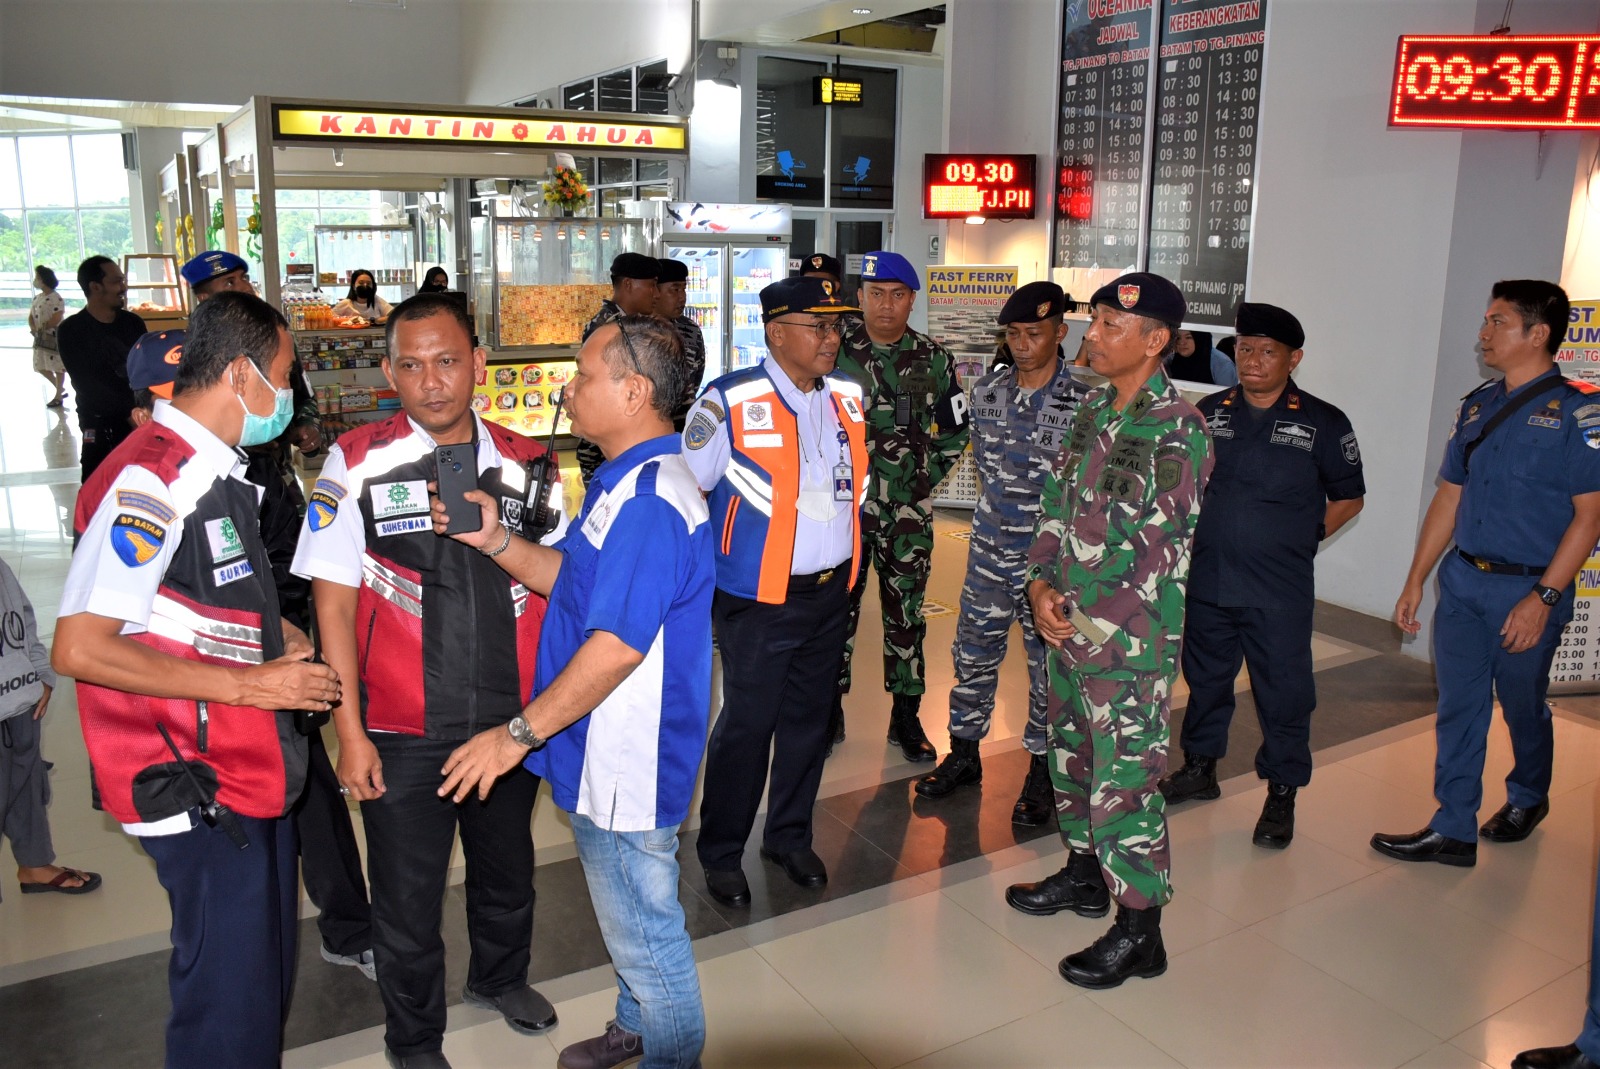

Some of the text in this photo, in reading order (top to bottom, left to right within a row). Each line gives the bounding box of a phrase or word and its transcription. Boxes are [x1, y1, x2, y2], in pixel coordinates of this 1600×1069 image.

[1169, 0, 1260, 34] KEBERANGKATAN
[1097, 22, 1139, 45] JADWAL
[1160, 30, 1265, 57] BATAM TO TG.PINANG
[1063, 47, 1151, 72] TG.PINANG TO BATAM
[1405, 55, 1562, 101] 09:30
[319, 114, 654, 146] KANTIN AHUA
[946, 163, 1014, 182] 09.30
[930, 271, 1014, 282] FAST FERRY
[929, 284, 1016, 294] ALUMINIUM
[1182, 280, 1193, 292] TG
[1195, 281, 1226, 295] PINANG
[1233, 283, 1244, 295] PP
[930, 297, 954, 305] BATAM
[971, 298, 998, 306] PINANG
[1186, 301, 1222, 316] CEANNA
[1569, 307, 1595, 323] ST
[1041, 414, 1069, 427] TNI A
[1272, 435, 1311, 449] COAST GUARD
[1111, 457, 1142, 471] TNI AL
[384, 503, 418, 512] UTAMAKAN
[121, 516, 163, 537] BP BATAM
[382, 518, 426, 533] SUHERMAN
[1564, 625, 1588, 634] 2.00
[1562, 638, 1587, 646] 2.30
[1557, 650, 1585, 659] 13.00
[1555, 662, 1583, 671] 13.30
[1553, 674, 1582, 682] 1400
